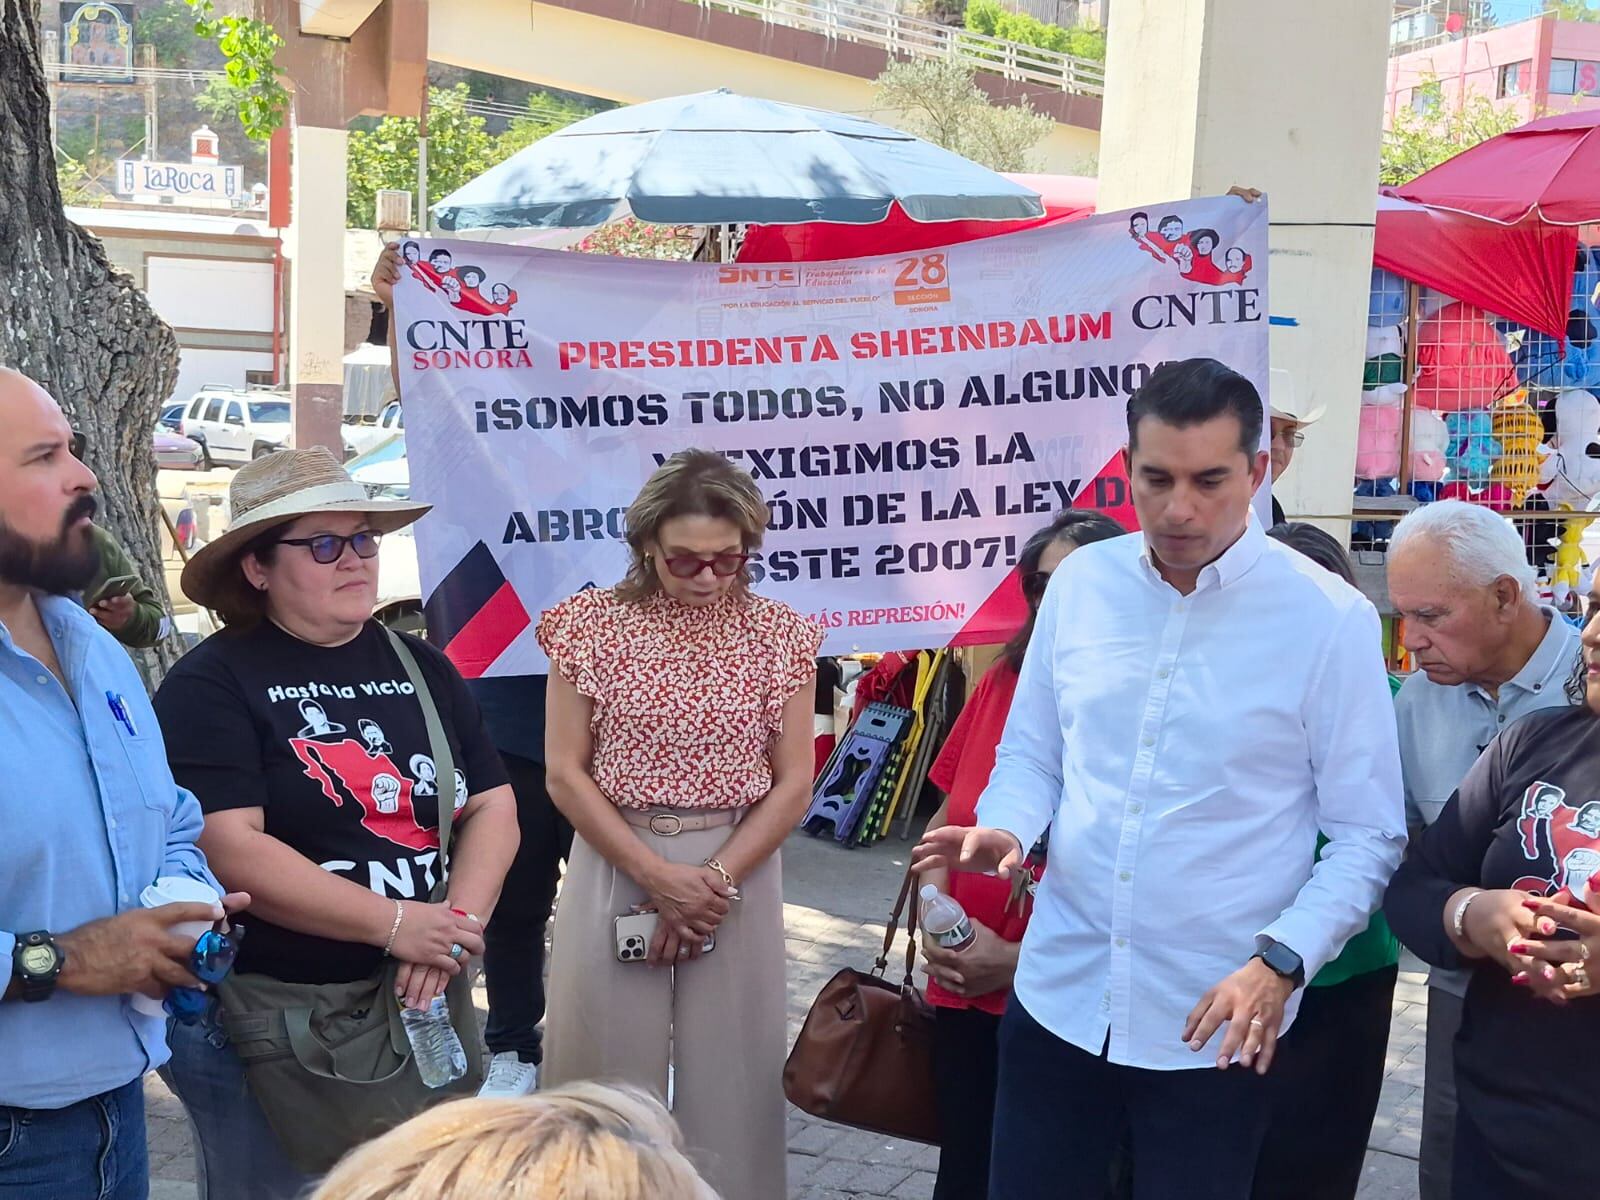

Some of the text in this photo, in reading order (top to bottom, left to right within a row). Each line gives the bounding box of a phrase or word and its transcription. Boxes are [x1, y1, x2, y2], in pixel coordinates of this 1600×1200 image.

[895, 253, 946, 286] 28
[1132, 289, 1261, 330] CNTE
[407, 319, 529, 351] CNTE
[559, 311, 1112, 370] PRESIDENTA SHEINBAUM
[413, 348, 533, 370] SONORA
[475, 361, 1178, 433] ¡SOMOS TODOS, NO ALGUNO
[975, 431, 1035, 466] LA
[843, 493, 906, 526] DE
[922, 488, 980, 521] LA
[995, 479, 1081, 516] LEY
[875, 535, 1017, 576] 2007!
[848, 601, 965, 627] REPRESIÓN!
[267, 681, 332, 702] Hasta
[333, 685, 356, 698] la
